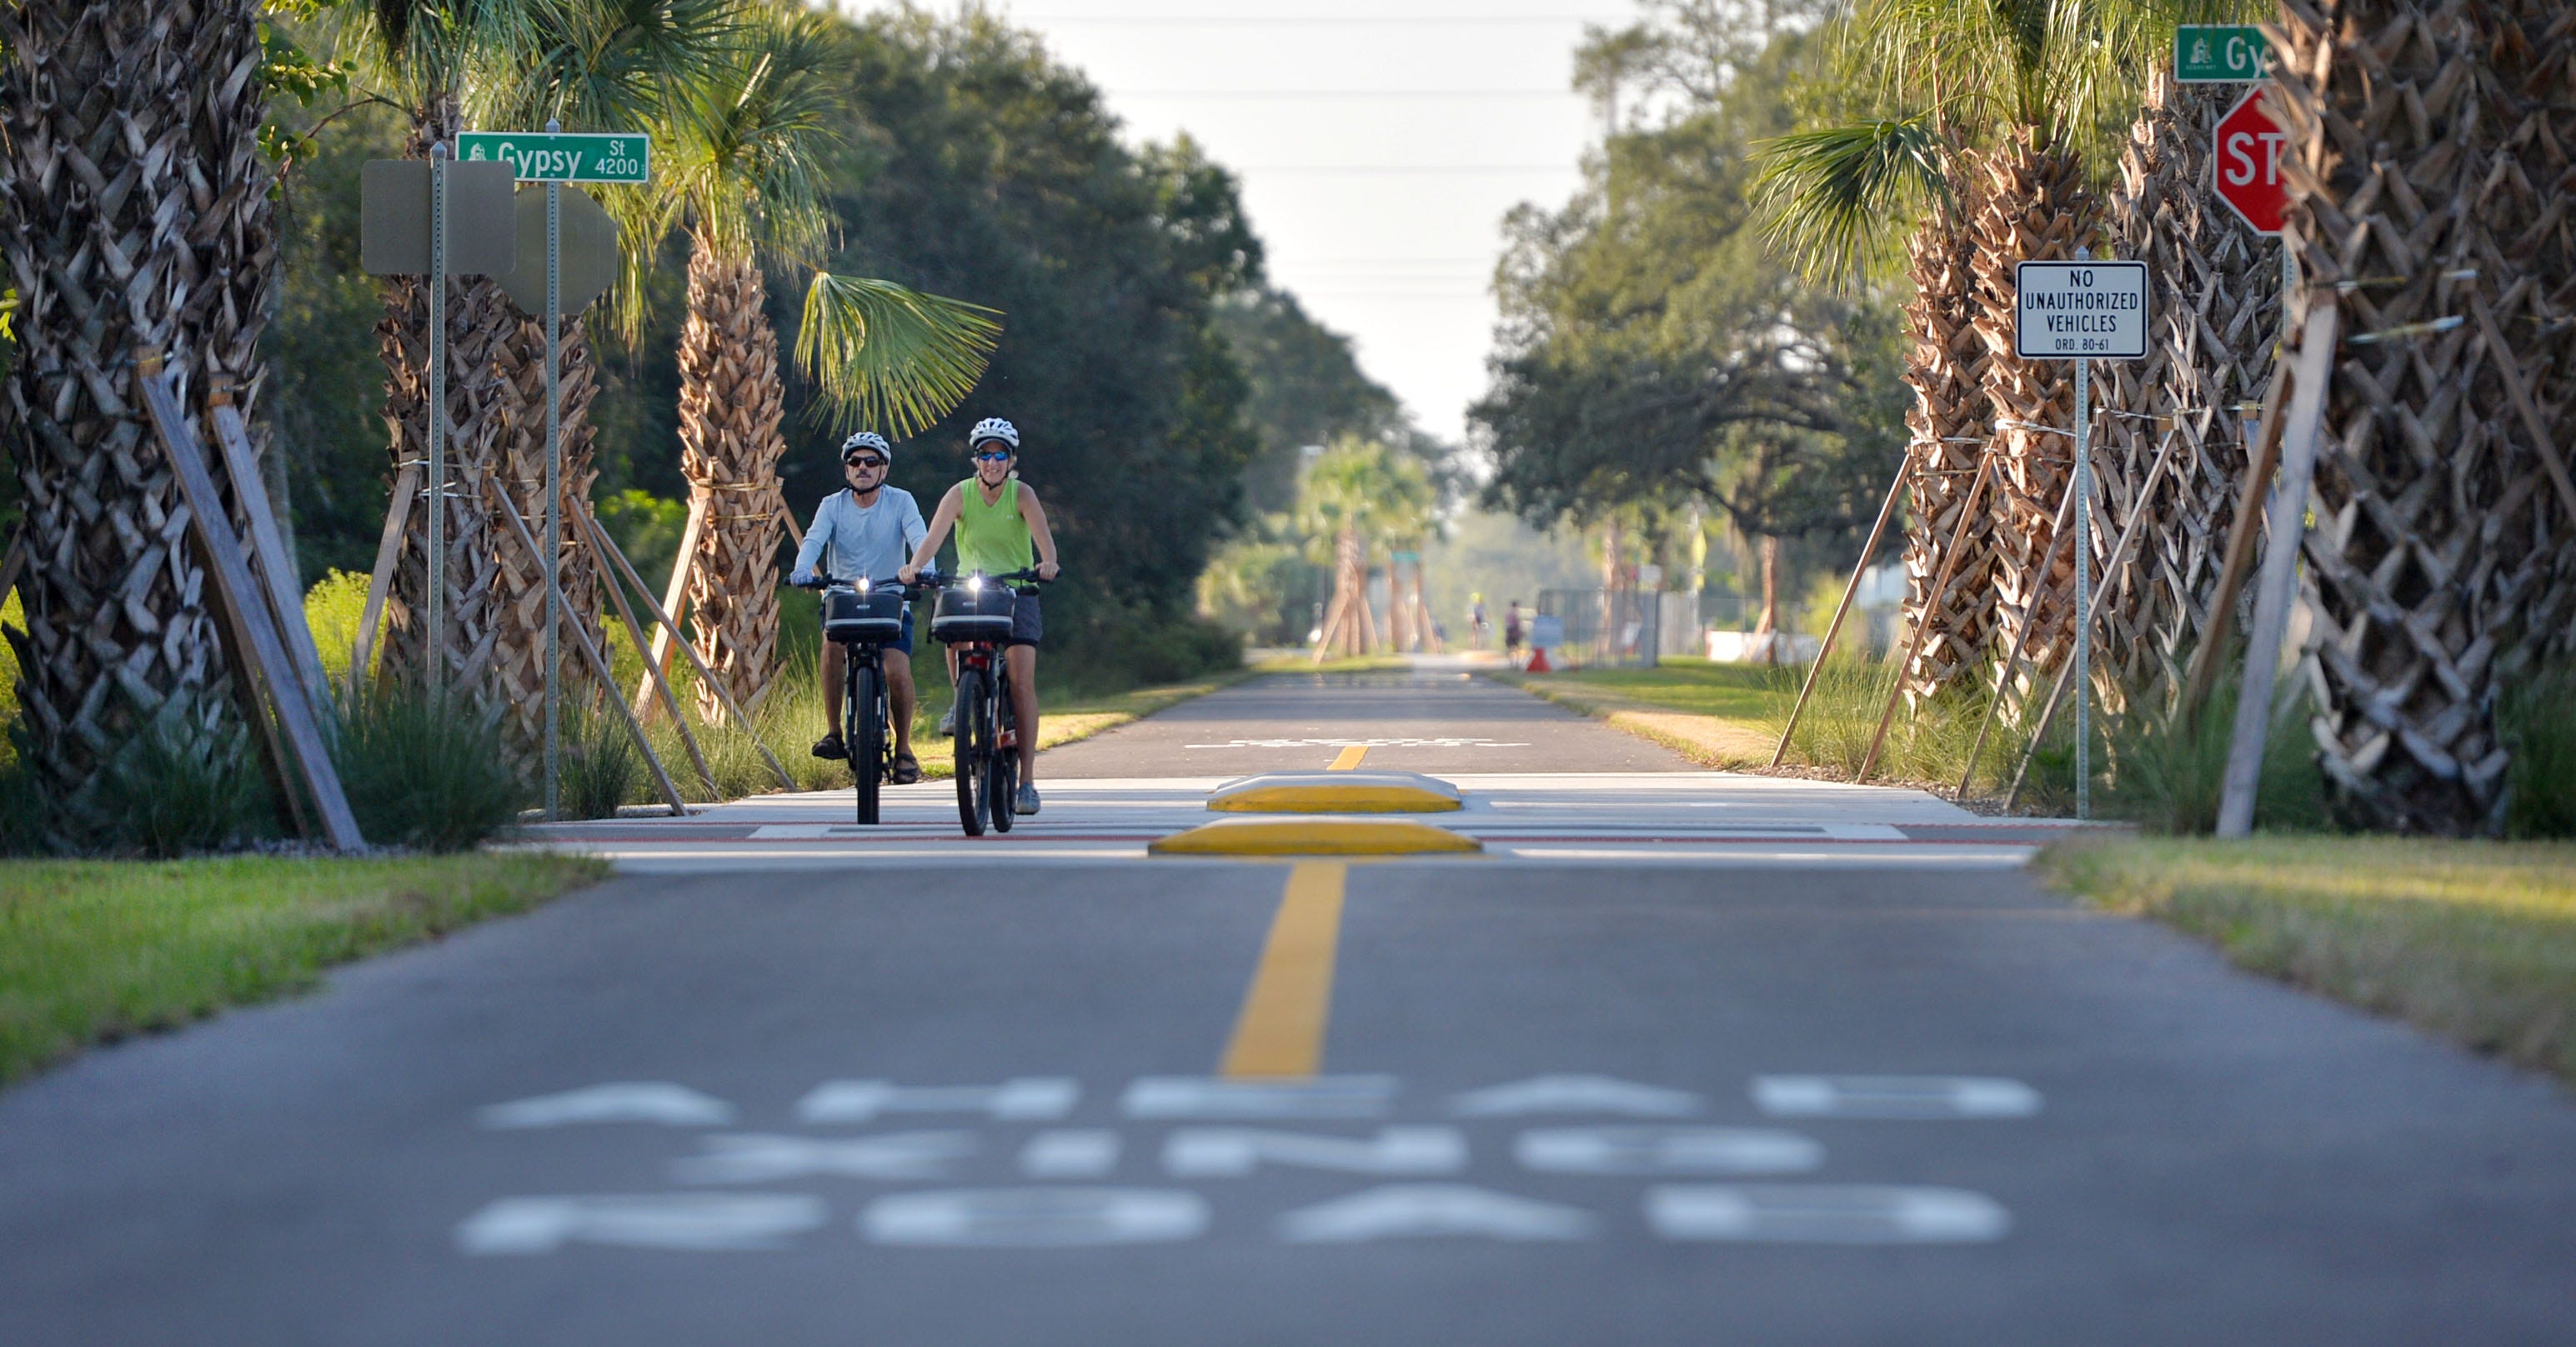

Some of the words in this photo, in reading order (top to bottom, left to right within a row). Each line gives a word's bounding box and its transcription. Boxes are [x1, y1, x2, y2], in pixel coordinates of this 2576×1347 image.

[2226, 36, 2273, 78] Gy
[498, 142, 583, 178] Gypsy
[609, 139, 625, 157] St
[594, 158, 638, 175] 4200
[2225, 131, 2286, 186] ST
[2070, 270, 2093, 287] NO
[2026, 293, 2137, 310] UNAUTHORIZED
[2047, 314, 2117, 333] VEHICLES
[2055, 338, 2078, 351] ORD.
[2082, 338, 2109, 351] 80-61
[469, 1074, 2045, 1129] AHEAD
[672, 1125, 1828, 1184] XING
[450, 1183, 2014, 1256] ROAD
